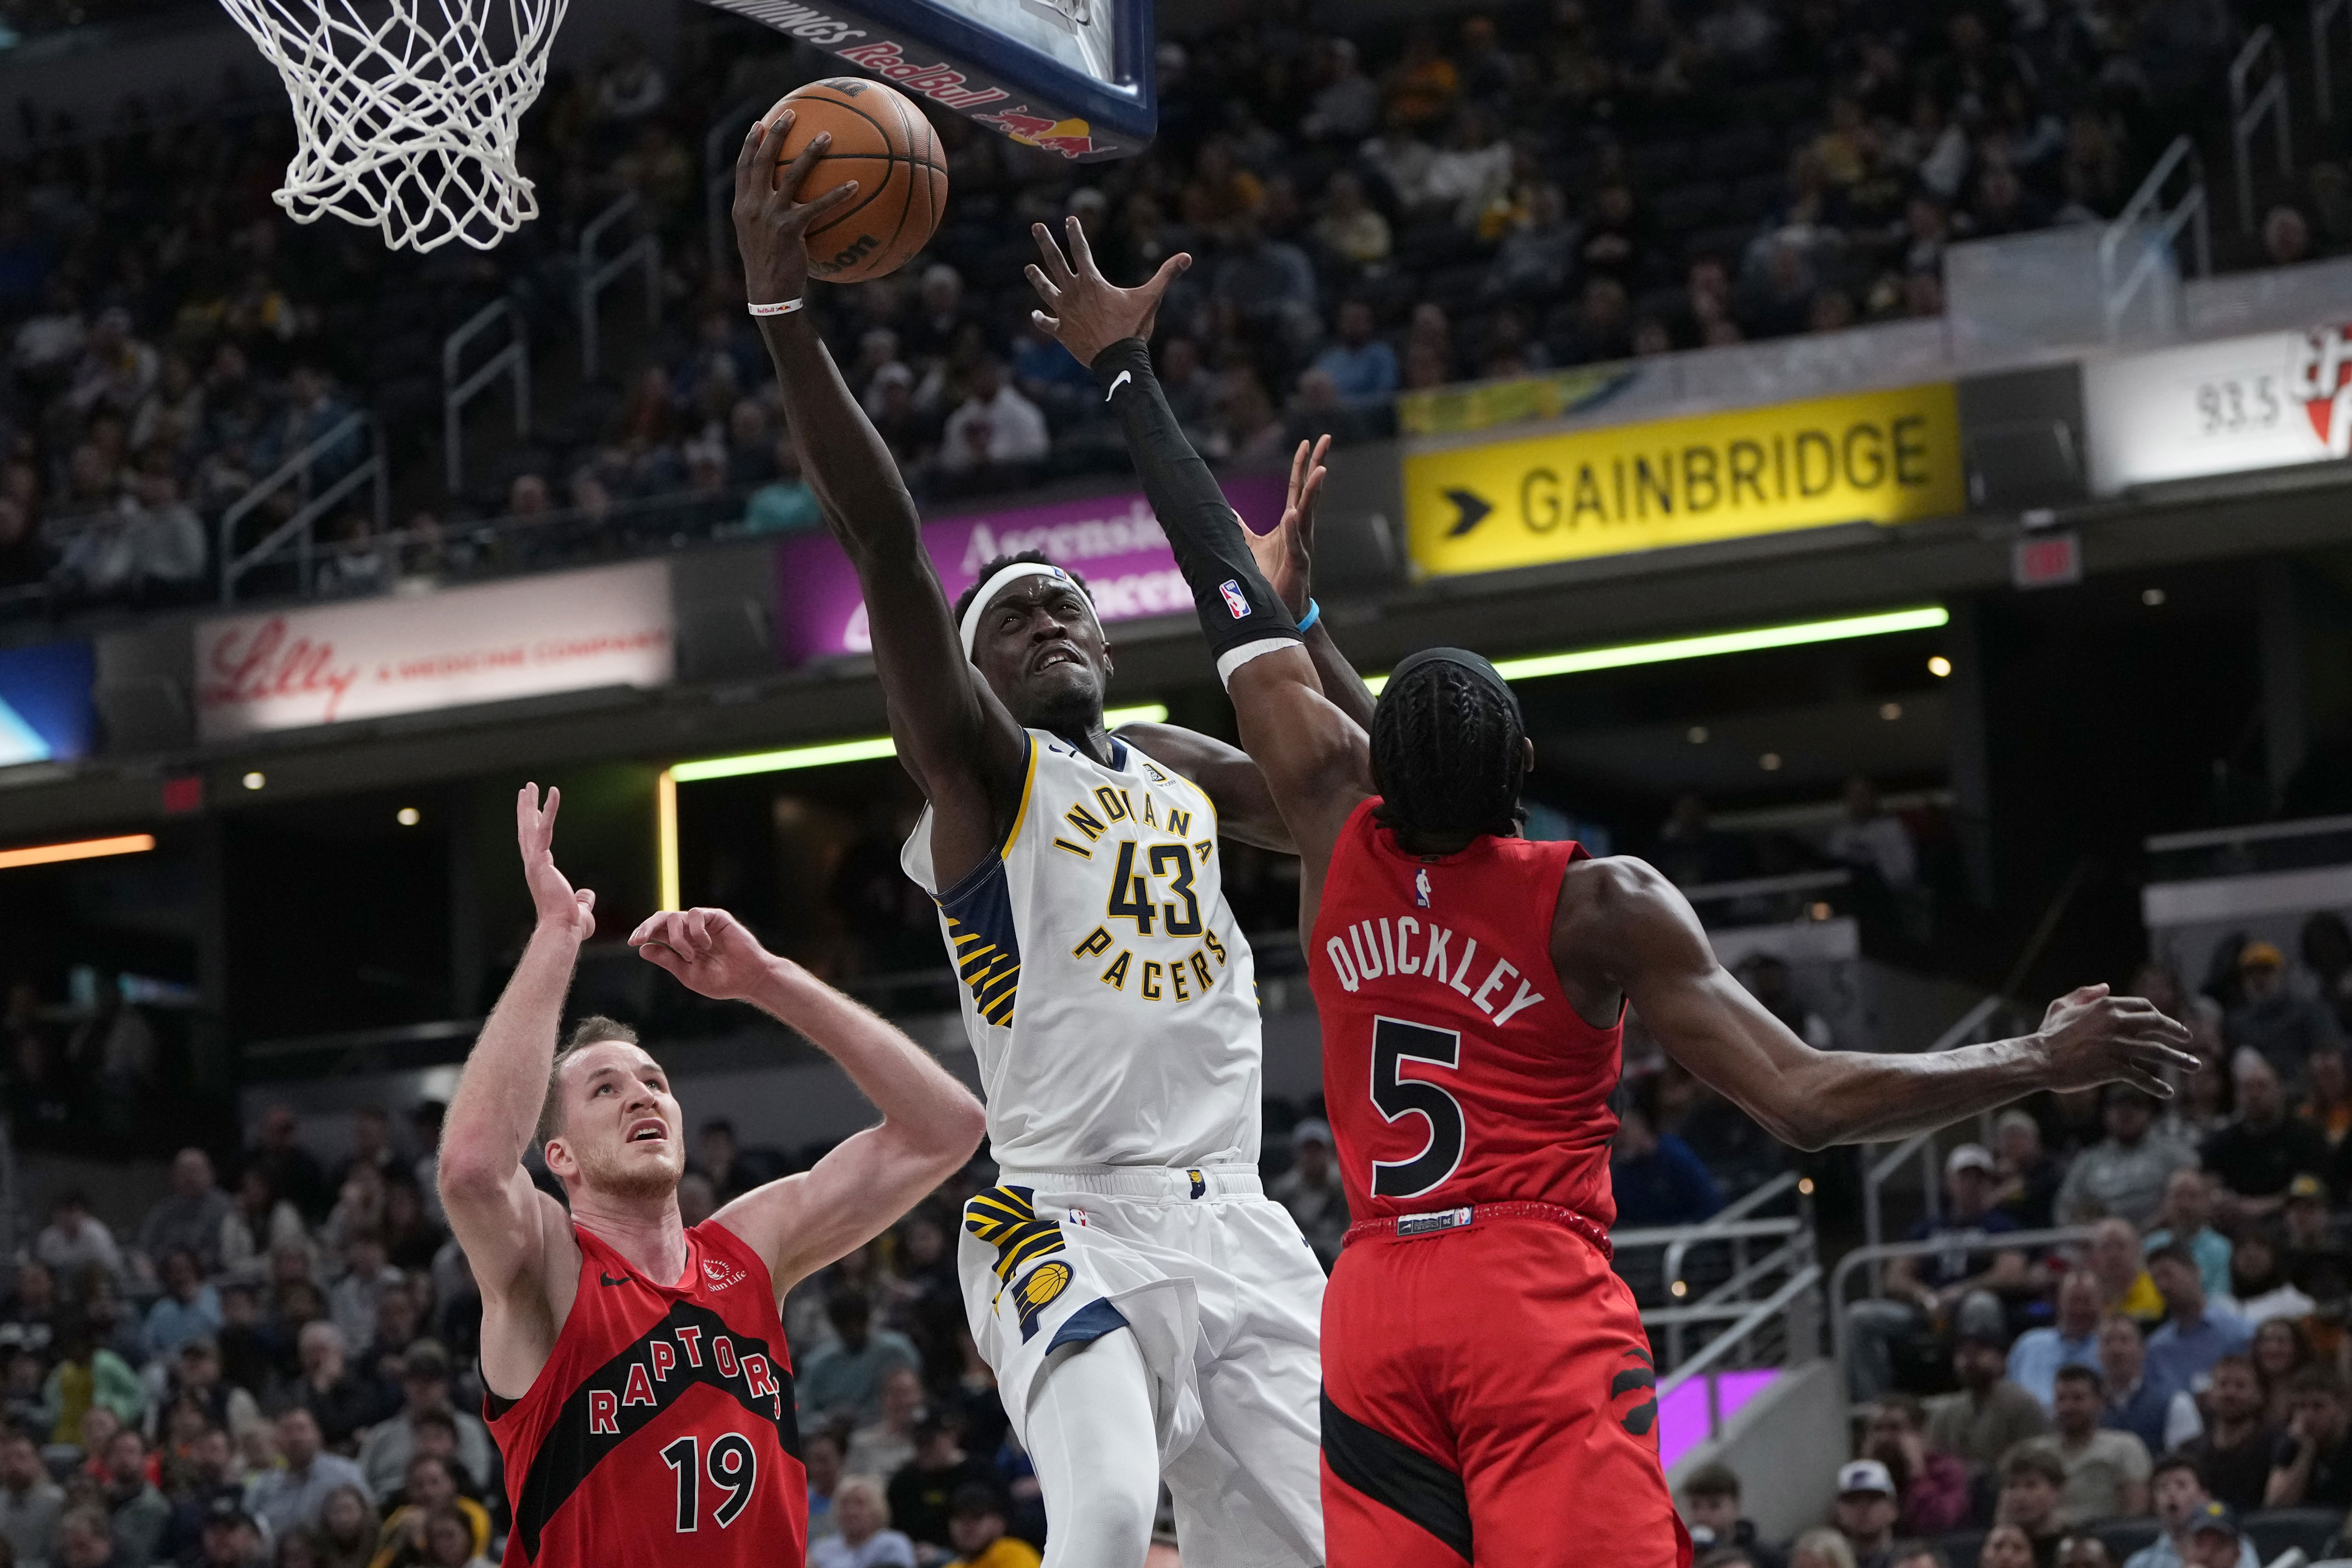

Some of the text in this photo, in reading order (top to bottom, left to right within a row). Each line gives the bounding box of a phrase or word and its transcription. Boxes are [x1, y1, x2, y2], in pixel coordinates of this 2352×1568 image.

[1521, 414, 1928, 534] GAINBRIDGE
[197, 615, 360, 722] Lilly
[1053, 785, 1213, 866] INDIANA
[1106, 840, 1205, 938] 43
[1072, 924, 1227, 1003] PACERS
[1327, 916, 1545, 1027] QUICKLEY
[1369, 1014, 1466, 1199] 5
[707, 1270, 747, 1292] Sun Life
[659, 1432, 758, 1533] 19
